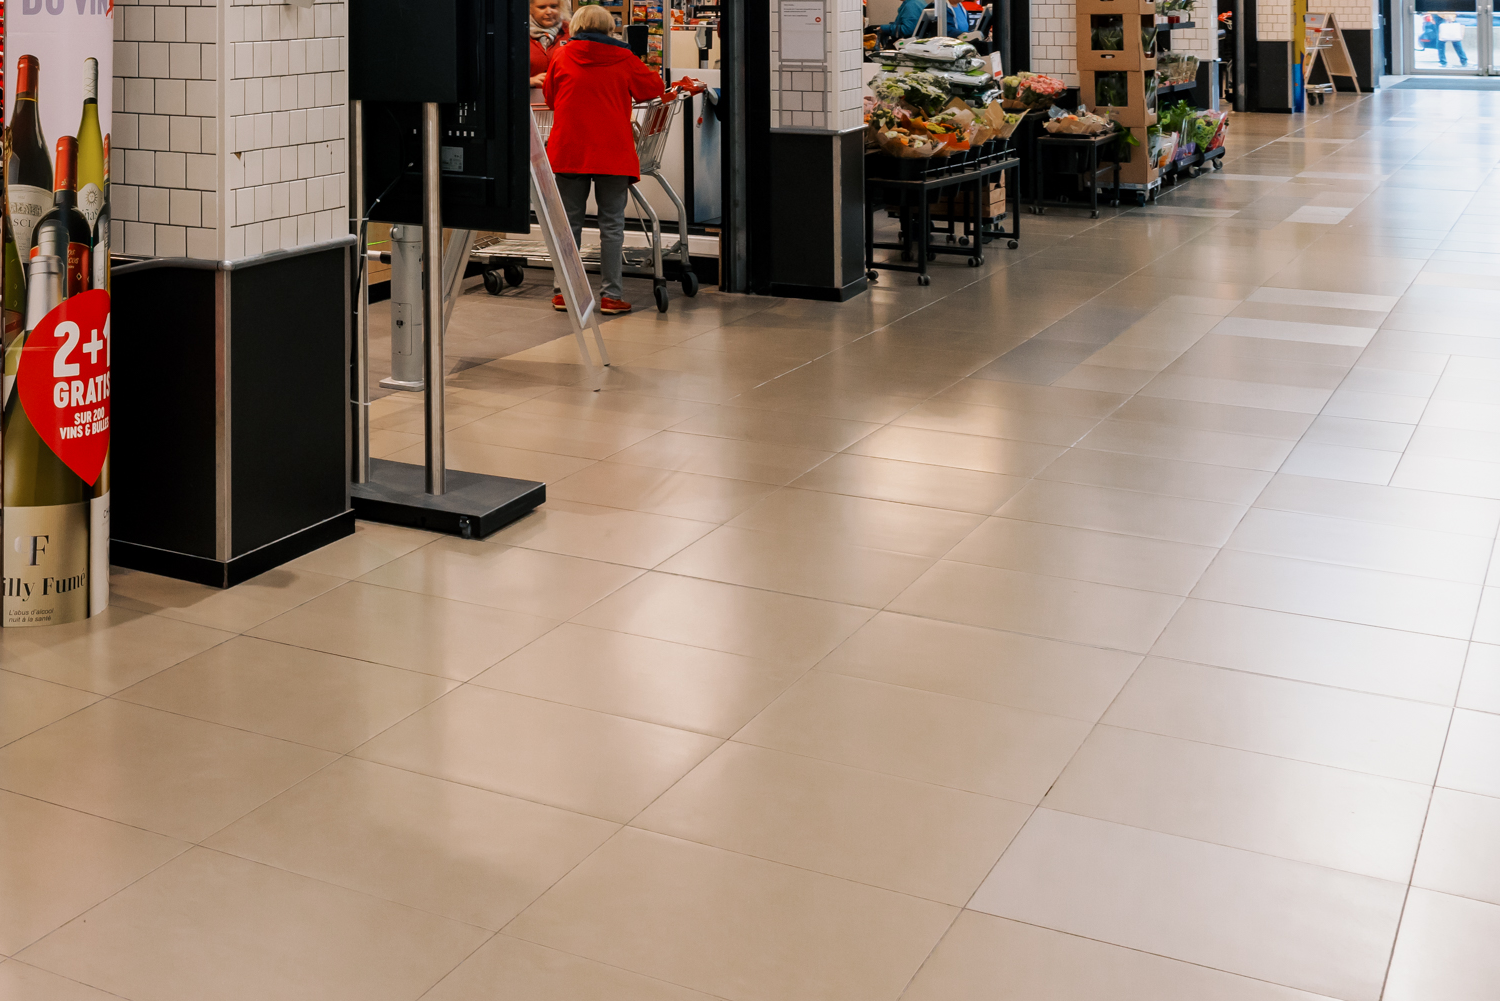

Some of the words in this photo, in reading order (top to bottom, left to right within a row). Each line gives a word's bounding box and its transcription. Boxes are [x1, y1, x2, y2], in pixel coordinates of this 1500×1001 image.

[53, 312, 110, 378] 2+1
[53, 371, 110, 409] GRATIS
[74, 411, 92, 425] SUR
[93, 406, 105, 422] 200
[59, 425, 83, 440] VINS
[85, 423, 91, 437] &
[42, 567, 86, 597] Fumé
